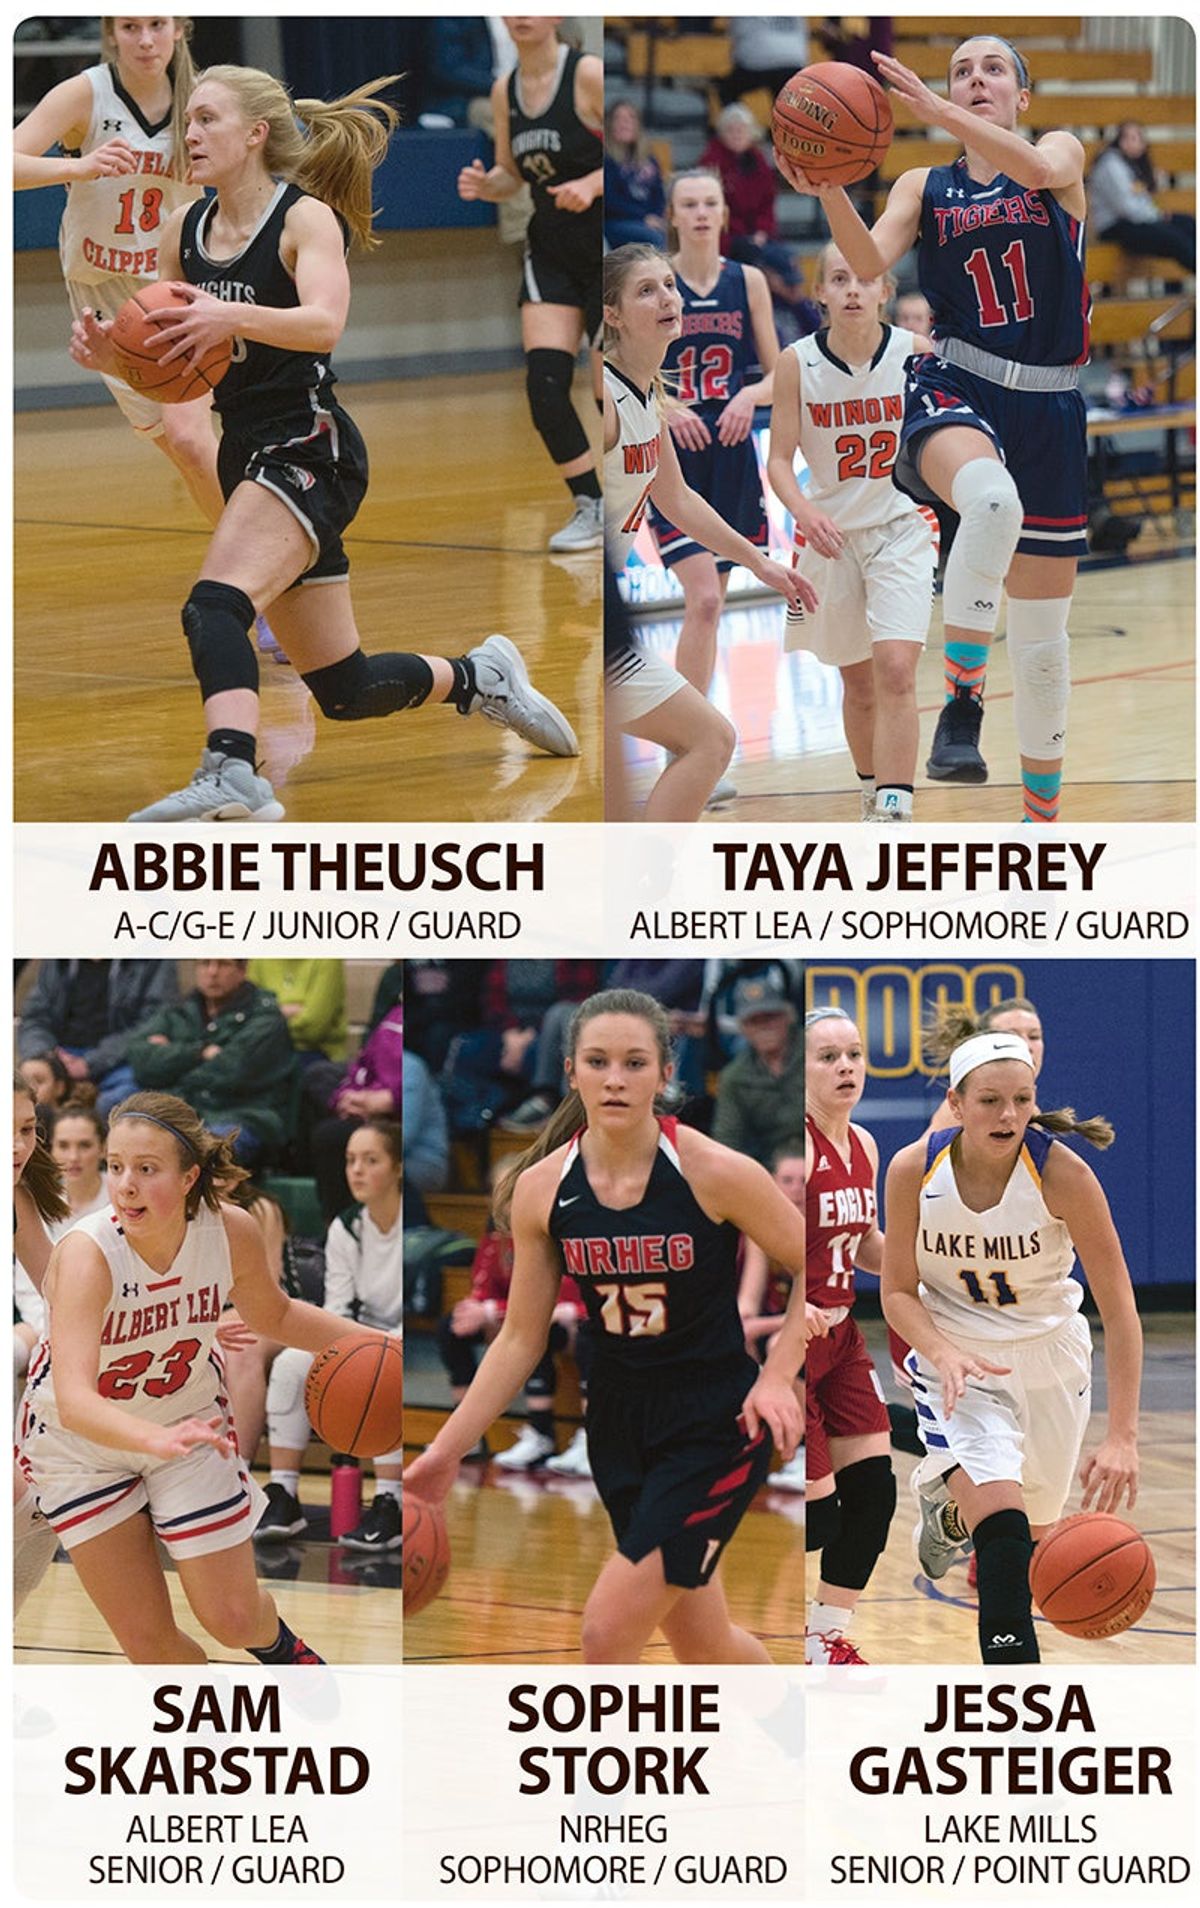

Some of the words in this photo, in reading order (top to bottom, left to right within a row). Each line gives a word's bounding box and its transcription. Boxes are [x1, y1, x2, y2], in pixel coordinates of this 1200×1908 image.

[781, 131, 825, 157] 1000
[114, 187, 164, 235] 13
[932, 189, 1050, 246] TIGERS
[82, 237, 159, 276] CLIPPE
[964, 239, 1034, 328] 11
[677, 344, 734, 401] 12
[806, 394, 903, 429] WINON
[835, 430, 897, 483] 22
[819, 1187, 876, 1228] EAGLE
[561, 1233, 694, 1275] NRHEG
[923, 1229, 975, 1258] LAKE
[983, 1231, 1040, 1261] MILLS
[594, 1282, 668, 1339] 15
[957, 1269, 1018, 1306] 11
[101, 1297, 180, 1345] ALBERT
[187, 1283, 220, 1323] LEA
[98, 1338, 202, 1400] 23
